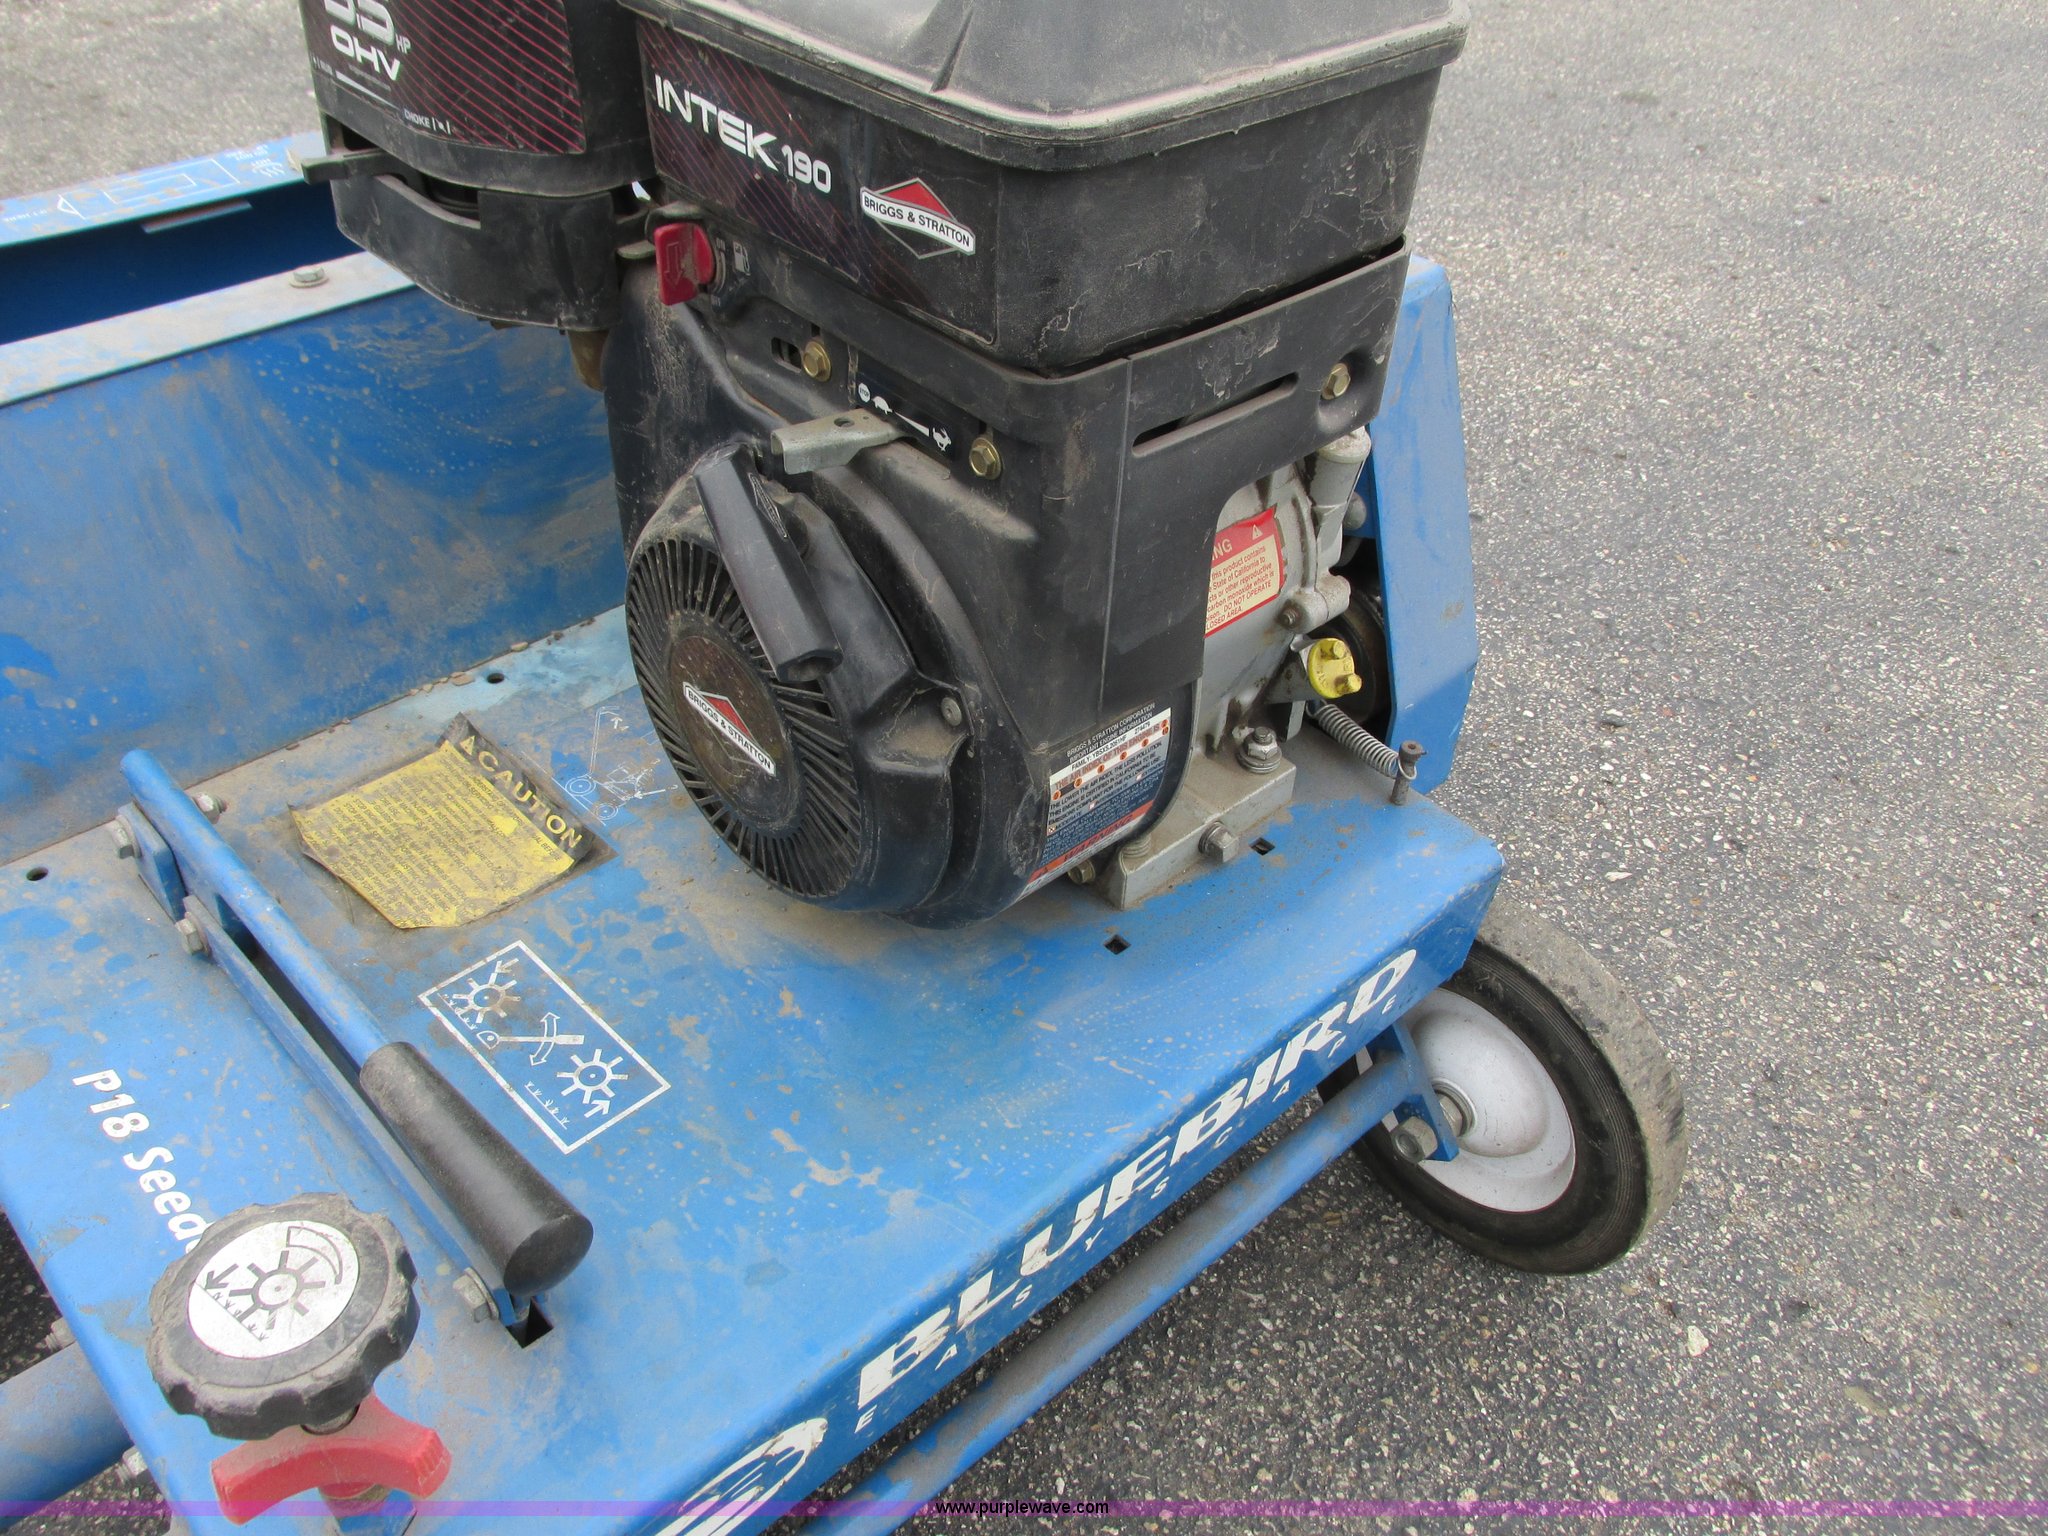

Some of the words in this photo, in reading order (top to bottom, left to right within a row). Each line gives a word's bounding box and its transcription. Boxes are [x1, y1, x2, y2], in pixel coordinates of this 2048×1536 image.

[330, 24, 401, 81] OHV
[395, 33, 412, 55] HP
[403, 107, 431, 129] CHOKE
[654, 74, 778, 172] INTEK
[781, 144, 832, 194] 190
[863, 195, 904, 222] BRIGGS
[906, 211, 916, 224] &
[918, 213, 971, 249] STRATTON
[1212, 575, 1226, 591] State
[1227, 572, 1233, 582] of
[1234, 557, 1259, 578] California
[1259, 554, 1265, 564] to
[1213, 538, 1232, 560] NG
[1222, 557, 1243, 574] product
[1239, 561, 1271, 586] reproductive
[1207, 596, 1226, 613] carbon
[1226, 581, 1251, 602] monoxide
[1253, 572, 1268, 587] which
[1223, 601, 1232, 613] DO
[1233, 594, 1244, 607] NOT
[1246, 578, 1271, 600] OPERATE
[687, 690, 719, 722] BRIGGS
[720, 720, 727, 729] &
[728, 725, 771, 770] STRATTON
[1067, 740, 1086, 758] BRIGGS
[1092, 722, 1118, 743] STRATTON
[1119, 701, 1155, 728] CORPORATION
[1069, 741, 1098, 764] IMPORTANT
[1099, 729, 1118, 746] ENGINE
[1119, 709, 1152, 735] INFORMATION
[1053, 774, 1069, 791] THE
[1069, 767, 1081, 781] AIR
[1082, 755, 1102, 774] INDEX
[1102, 749, 1112, 762] OF
[1113, 740, 1127, 756] THIS
[1128, 726, 1152, 747] ENGINE
[1071, 753, 1092, 771] FAMILY:
[477, 749, 584, 850] CAUTION
[72, 1069, 149, 1138] P18
[122, 1146, 217, 1255] Seed
[858, 949, 1417, 1410] BLUEBIRD
